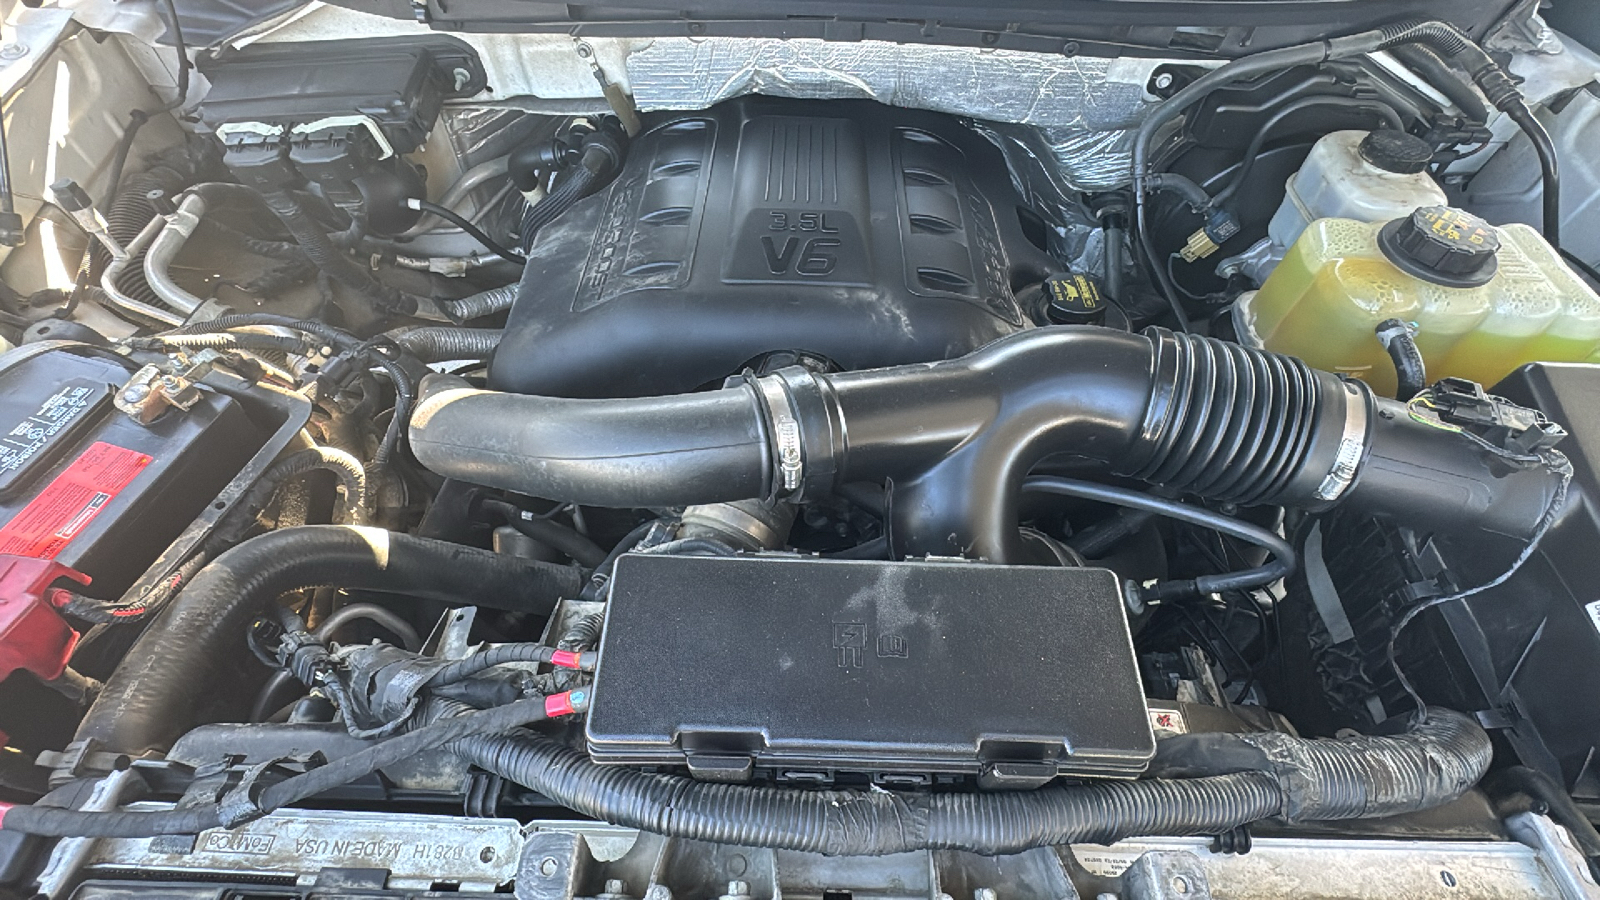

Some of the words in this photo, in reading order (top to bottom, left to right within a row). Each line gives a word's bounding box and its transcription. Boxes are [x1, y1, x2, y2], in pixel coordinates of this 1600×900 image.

[768, 211, 839, 232] 3.5L
[760, 235, 841, 276] V6
[296, 837, 328, 855] USA
[332, 838, 351, 853] IN
[354, 838, 401, 855] MADE
